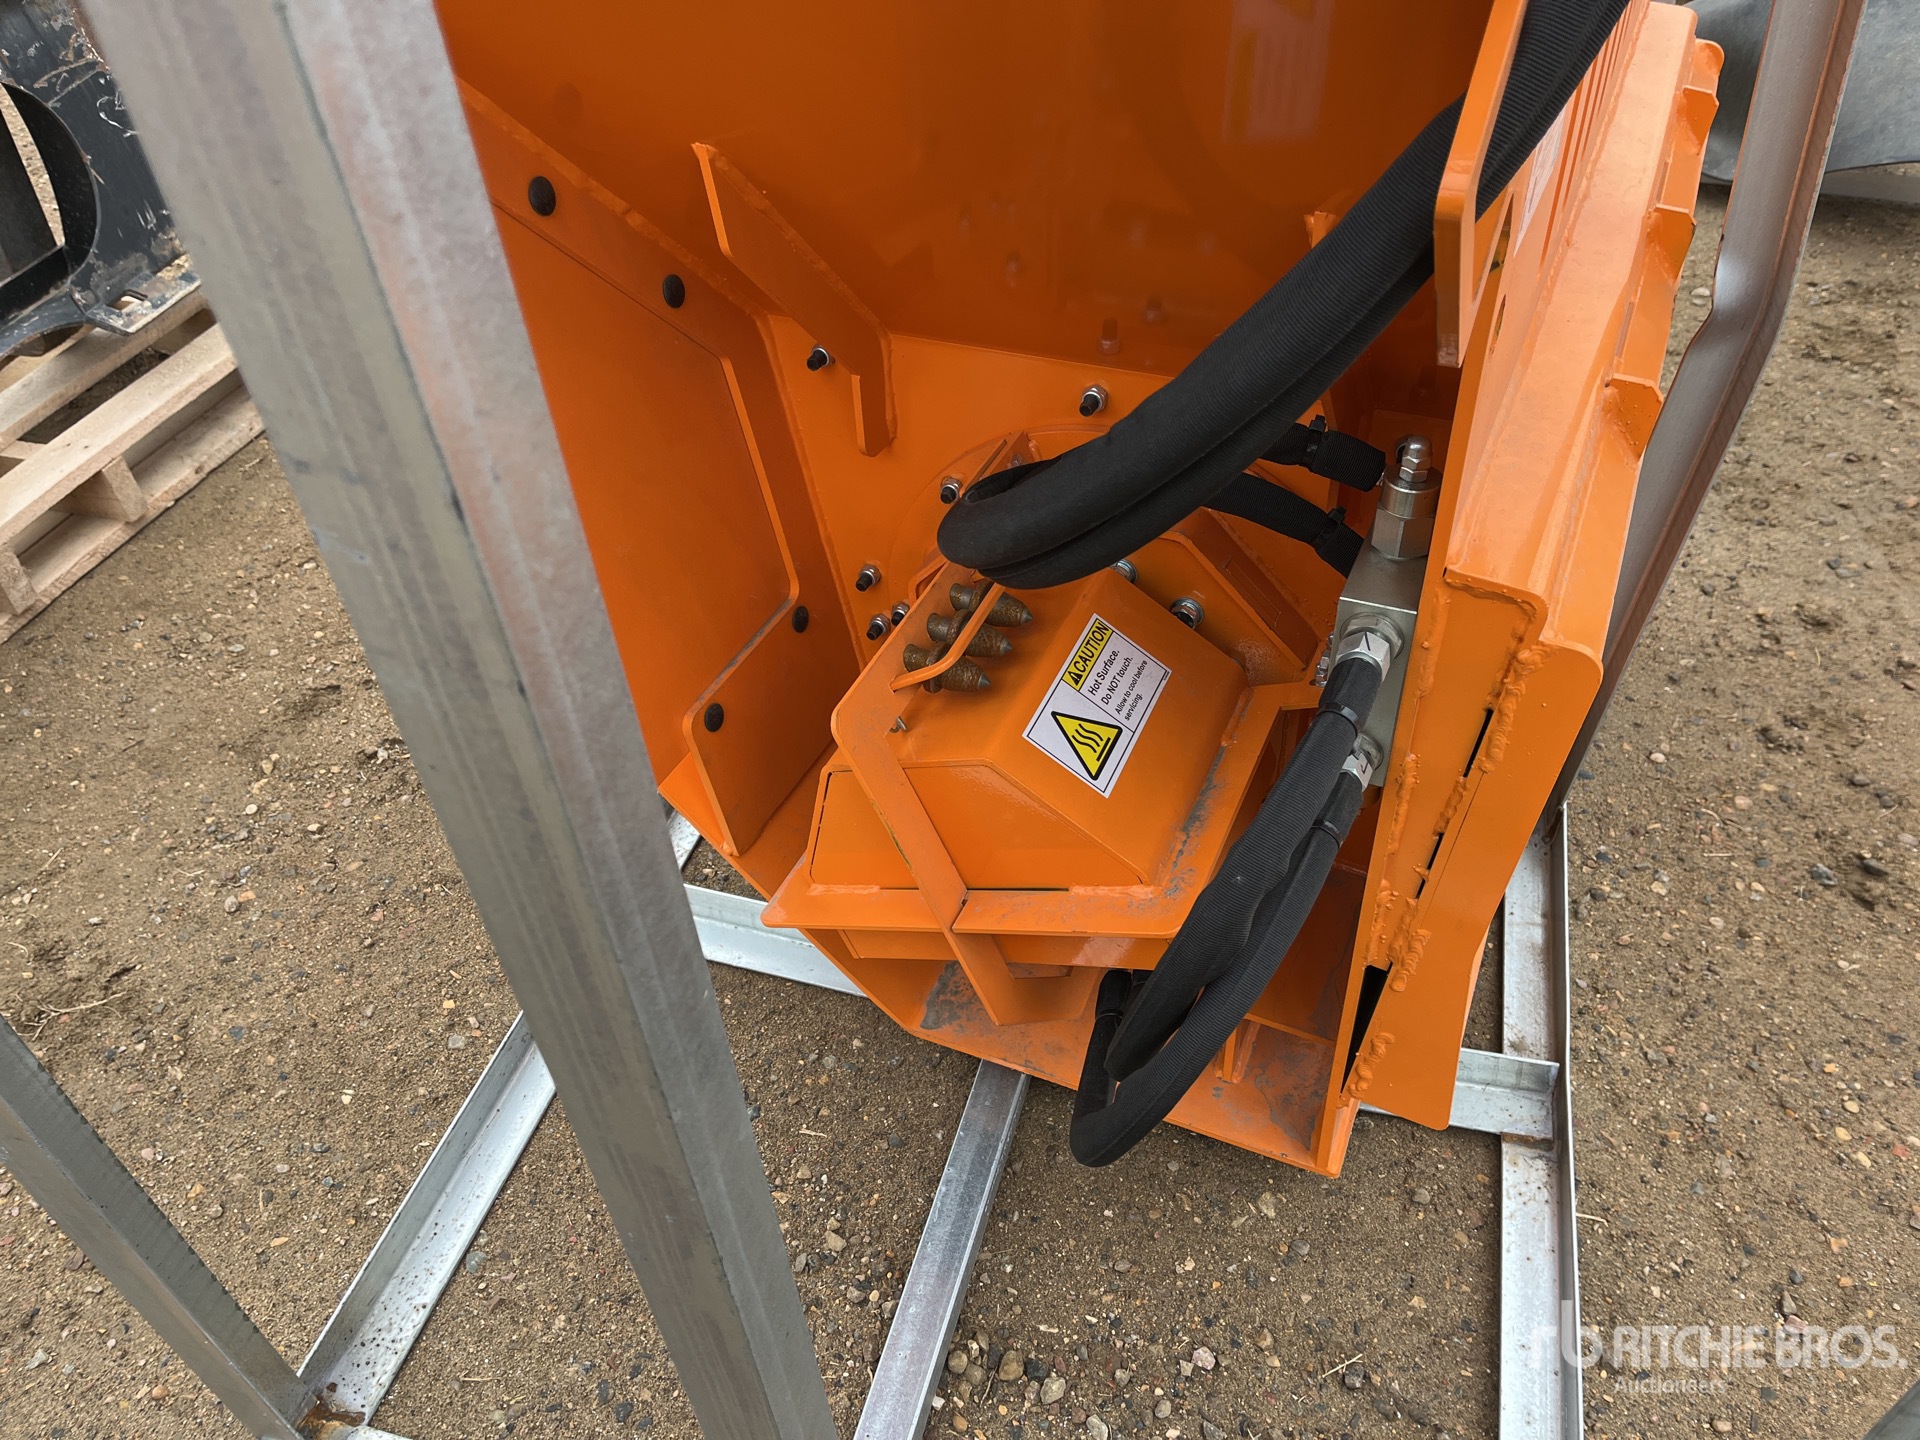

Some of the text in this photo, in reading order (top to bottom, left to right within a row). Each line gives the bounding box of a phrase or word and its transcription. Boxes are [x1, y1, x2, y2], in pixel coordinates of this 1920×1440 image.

[1073, 621, 1110, 673] CAUTION
[1087, 650, 1120, 696] Hot Surface.
[1100, 656, 1134, 705] Do NOT touch.
[1114, 660, 1148, 715] Allow to cool before
[1124, 693, 1143, 722] servicing.
